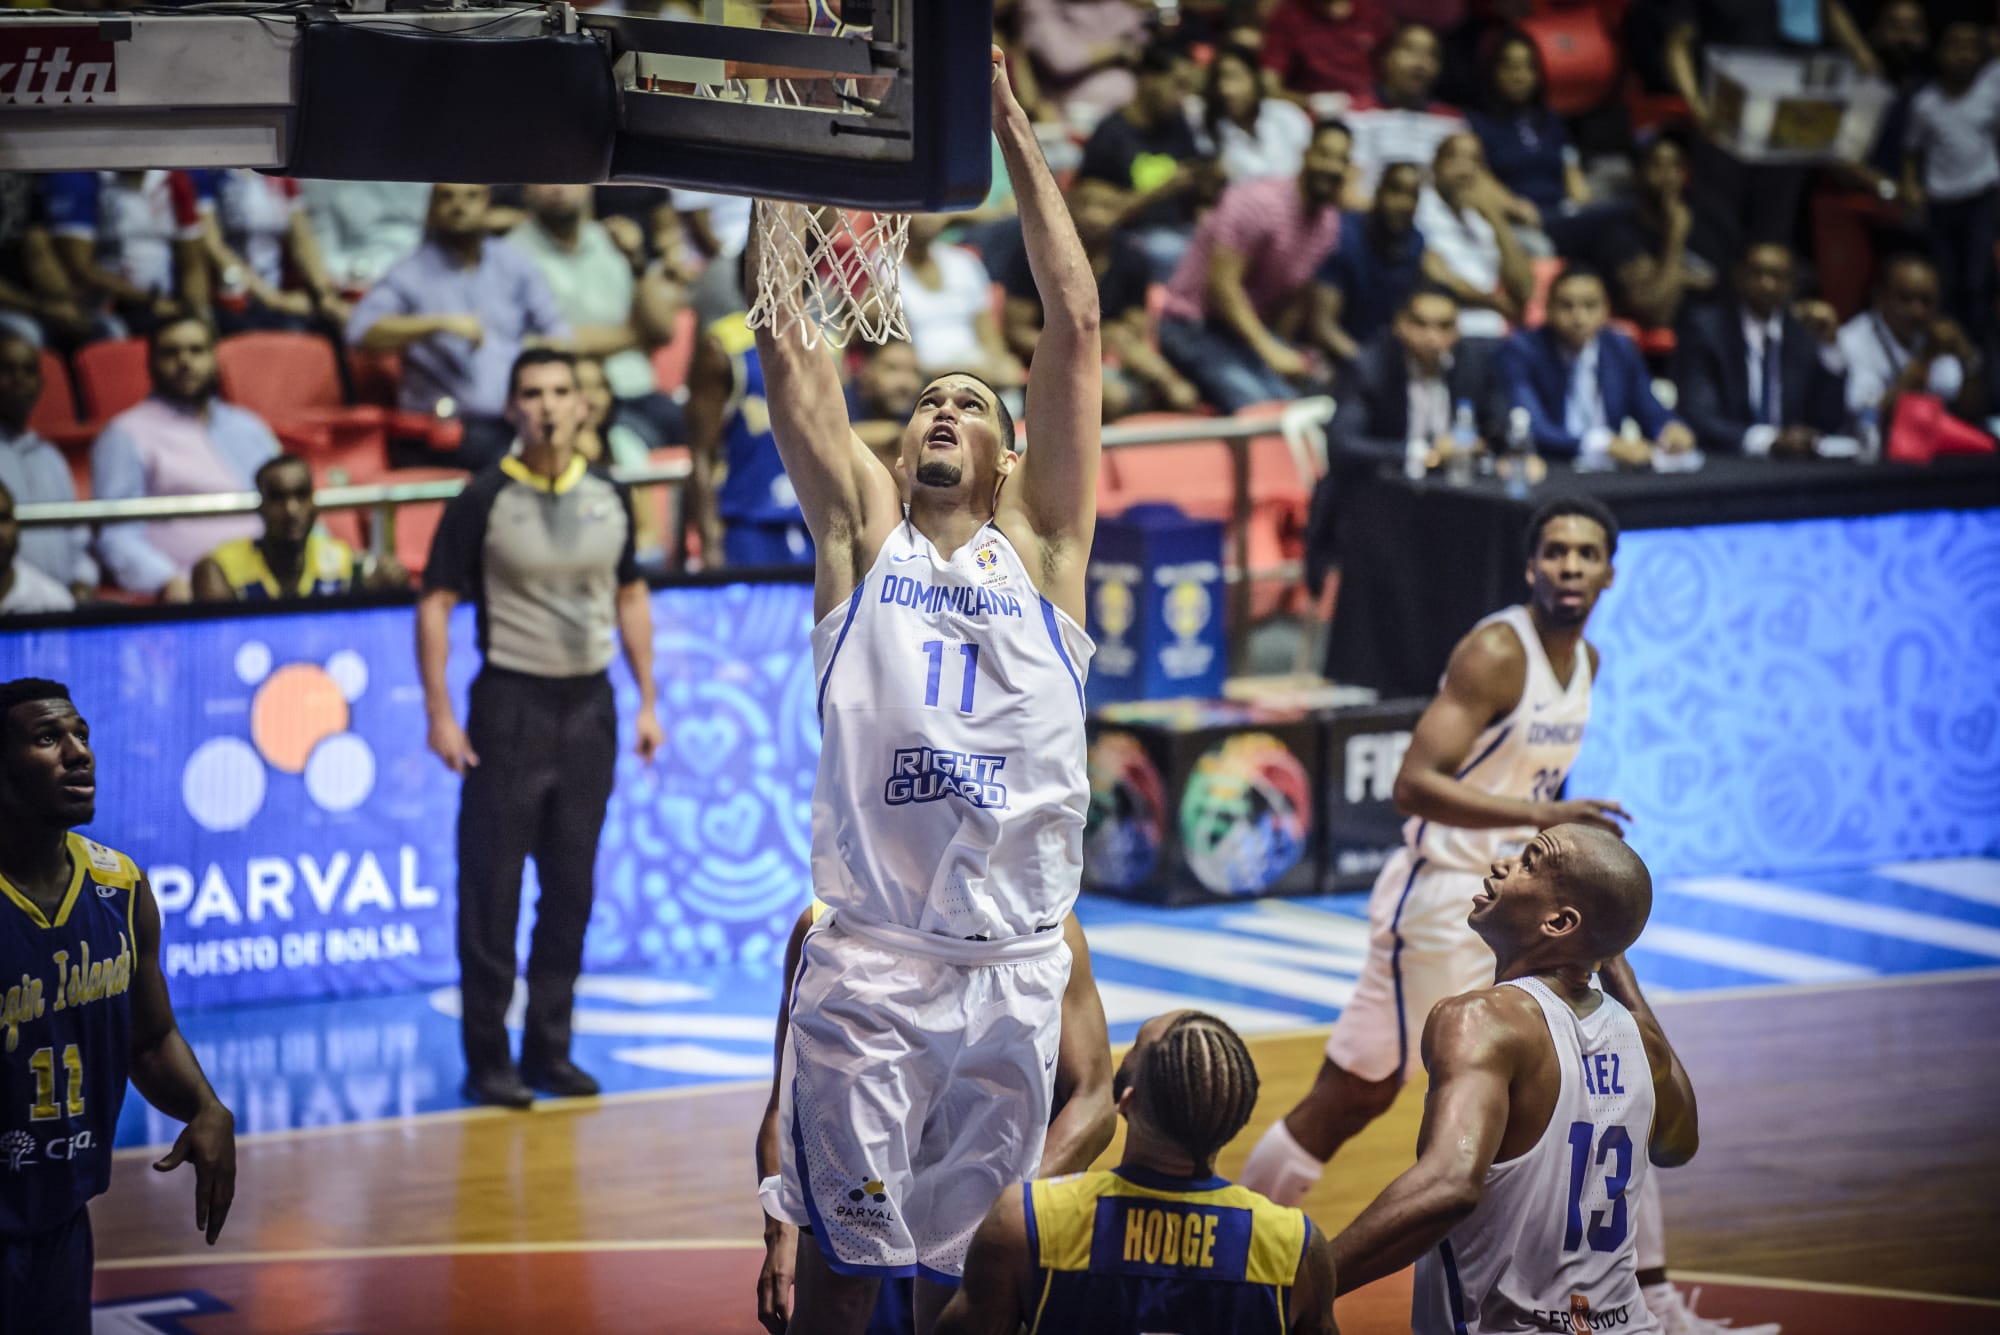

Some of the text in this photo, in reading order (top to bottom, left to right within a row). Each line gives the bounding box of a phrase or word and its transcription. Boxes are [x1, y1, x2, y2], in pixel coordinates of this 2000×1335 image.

[880, 574, 1022, 618] DOMINICANA
[922, 640, 980, 714] 11
[885, 775, 1008, 809] GUARD
[894, 748, 1006, 784] RIGHT
[148, 845, 439, 929] PARVAL
[166, 921, 420, 978] PUESTO DE BOLSA
[0, 973, 45, 1052] gin
[29, 1044, 85, 1121] 11
[836, 1206, 894, 1221] PARVAL
[1563, 1121, 1633, 1253] 13
[1123, 1208, 1219, 1268] HODGE
